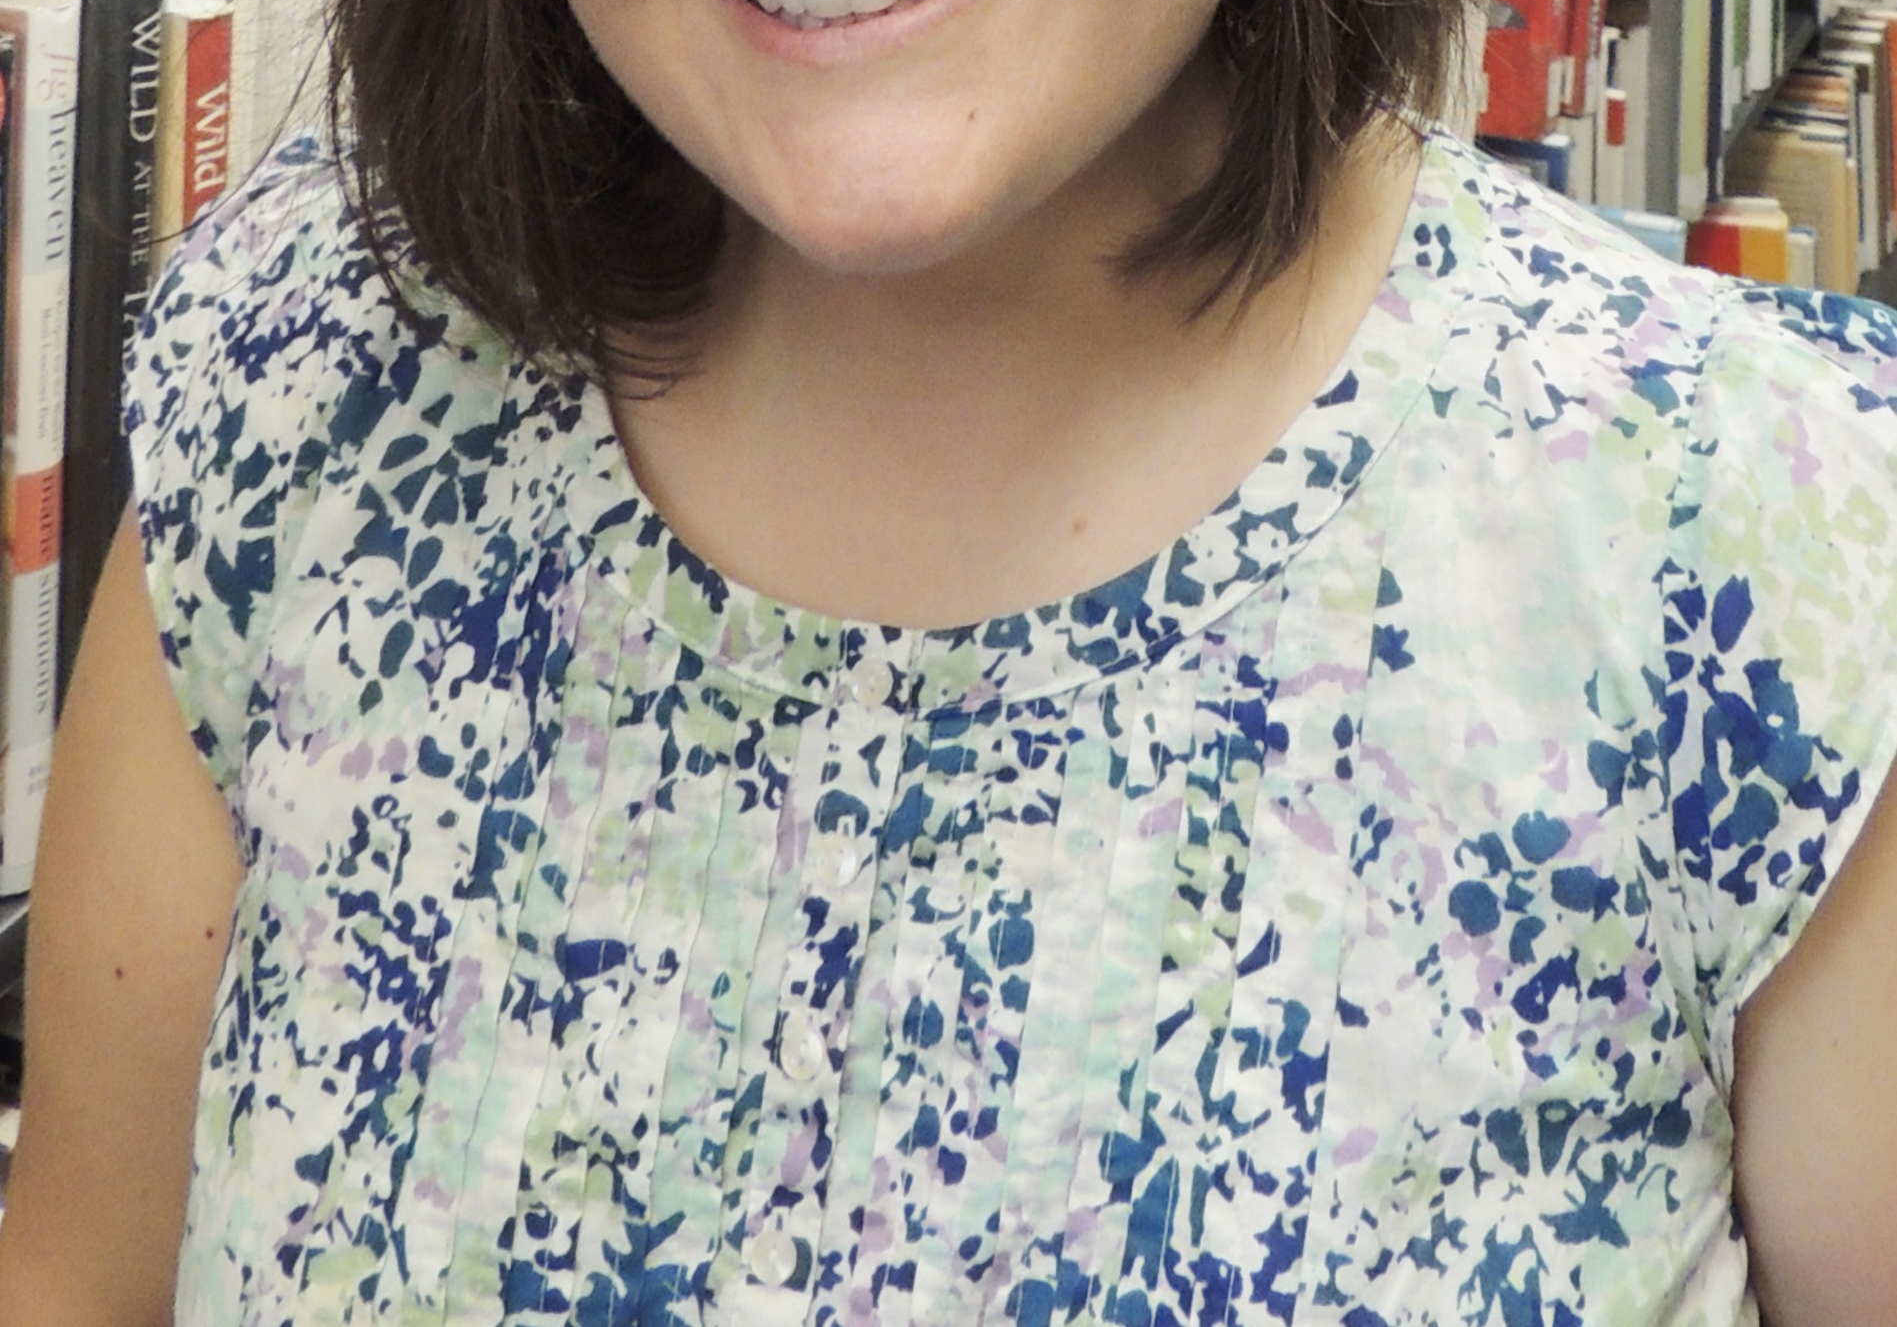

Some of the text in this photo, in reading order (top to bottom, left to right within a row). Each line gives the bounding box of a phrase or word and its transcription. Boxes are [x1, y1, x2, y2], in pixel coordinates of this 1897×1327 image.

[129, 12, 162, 142] WILD
[132, 160, 151, 194] AT
[194, 80, 228, 194] Wild
[130, 204, 150, 267] THE
[39, 475, 56, 561] marie
[36, 572, 52, 716] simmons
